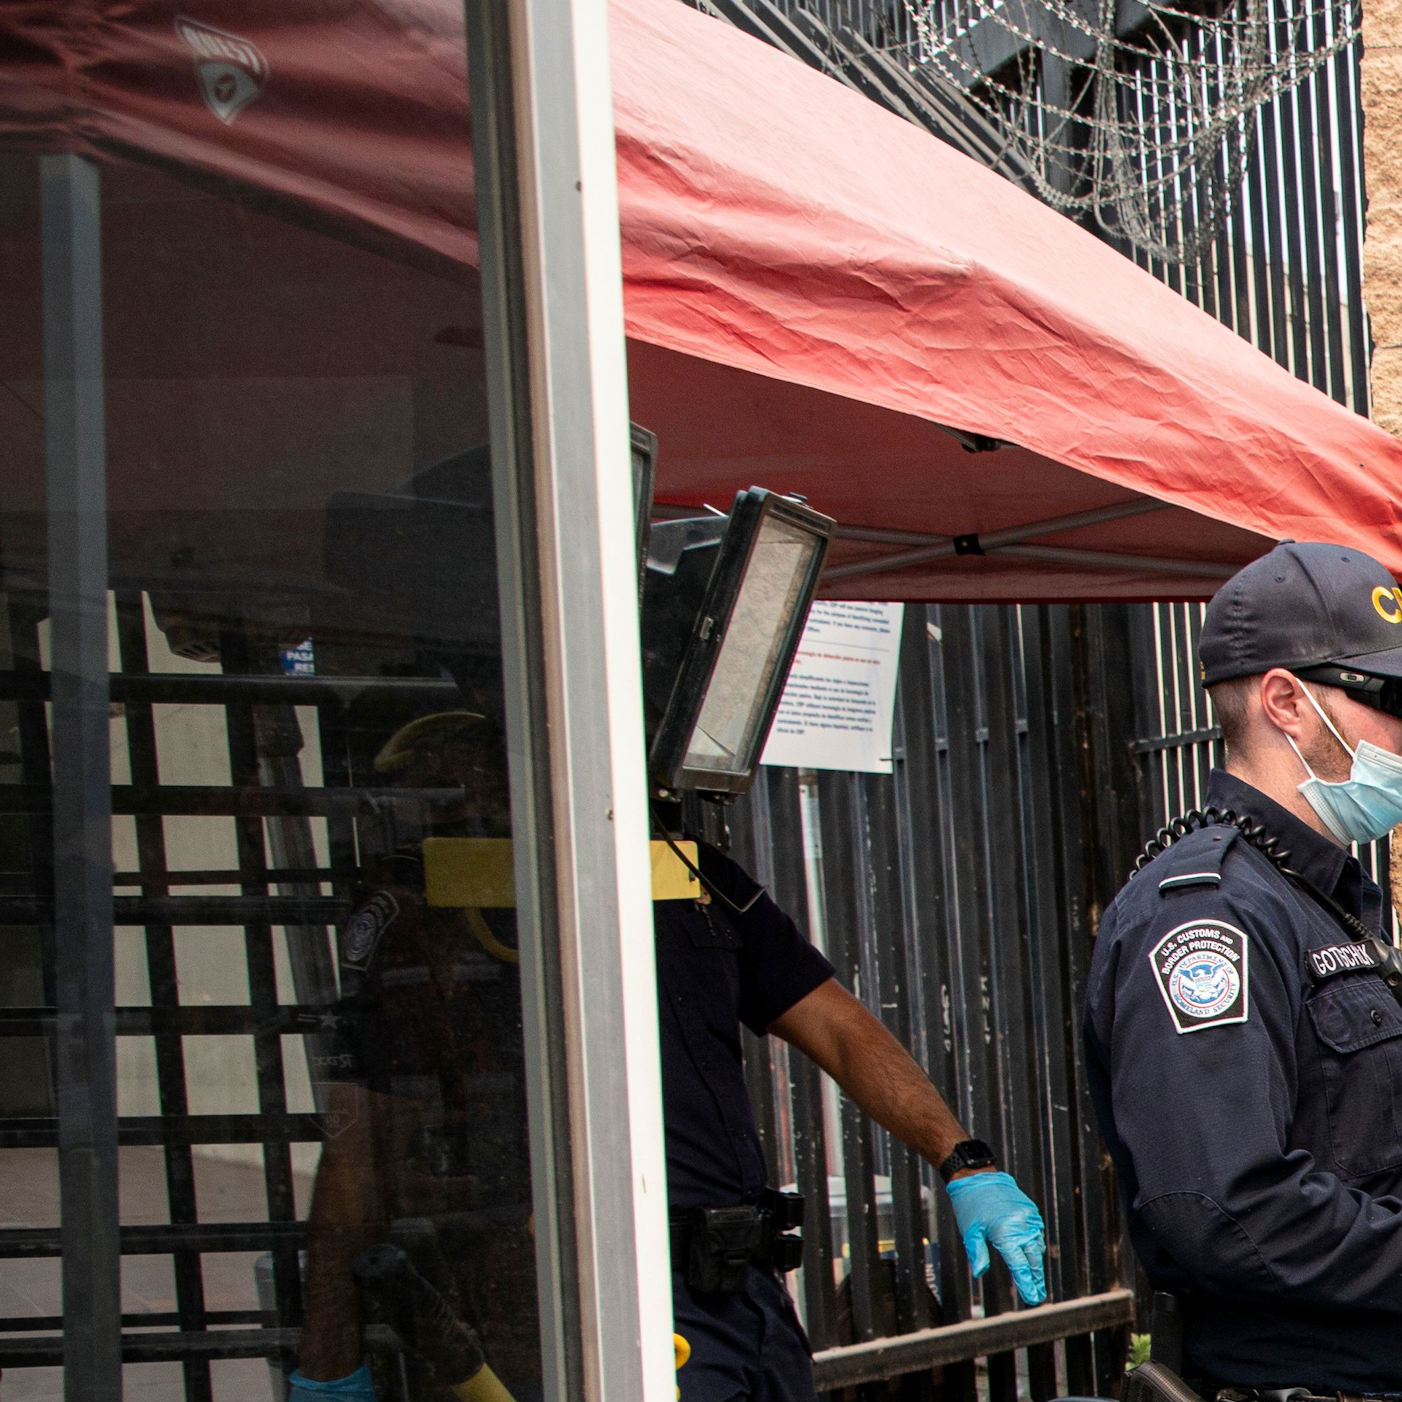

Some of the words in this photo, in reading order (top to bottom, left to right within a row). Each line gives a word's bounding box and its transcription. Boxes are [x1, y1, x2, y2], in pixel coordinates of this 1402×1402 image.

[1161, 942, 1178, 957] U.S.
[1177, 929, 1220, 944] CUSTOMS
[1220, 935, 1234, 945] AND
[1161, 945, 1190, 975] BORDER
[1189, 940, 1240, 963] PROTECTION
